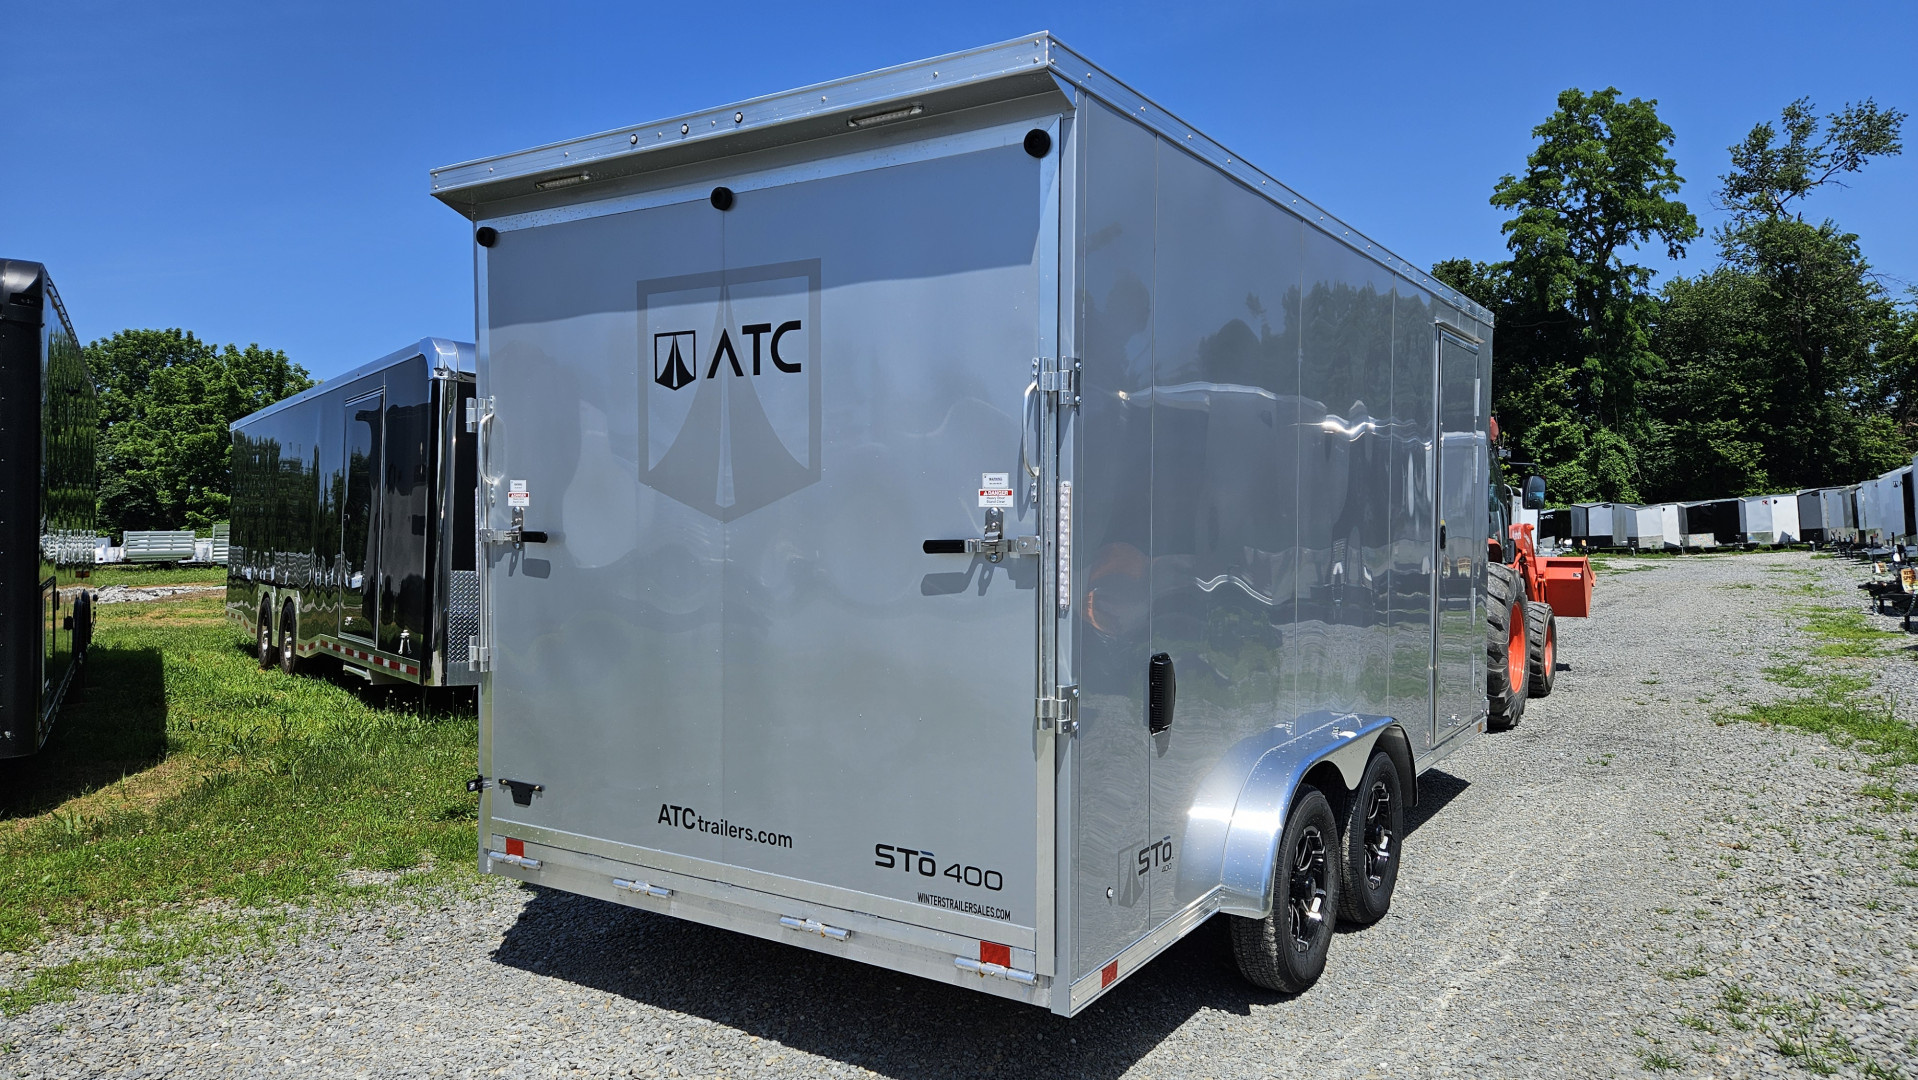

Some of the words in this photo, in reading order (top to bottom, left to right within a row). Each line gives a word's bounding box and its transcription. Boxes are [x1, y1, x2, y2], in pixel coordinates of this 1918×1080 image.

[707, 320, 801, 379] ATC
[943, 863, 1003, 891] 400
[917, 891, 1011, 922] WINTERSTRAILERSALES.COM
